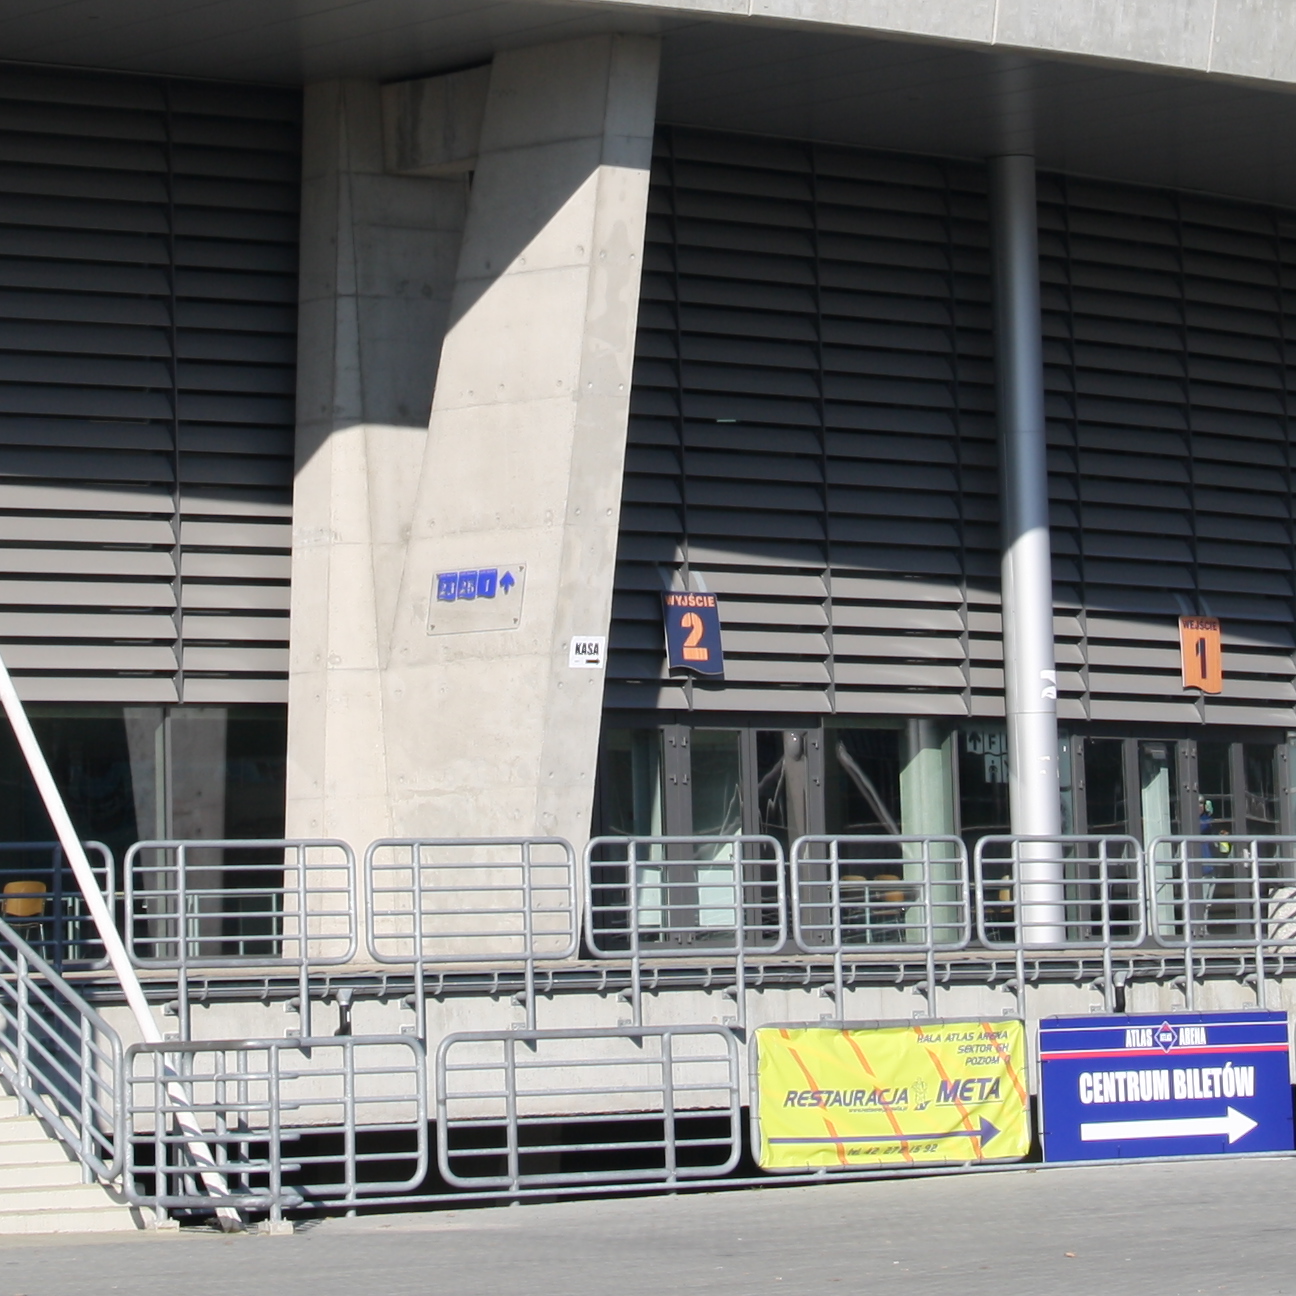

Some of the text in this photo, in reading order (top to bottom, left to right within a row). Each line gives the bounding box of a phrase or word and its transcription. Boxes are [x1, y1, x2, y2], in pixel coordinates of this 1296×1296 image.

[484, 578, 491, 593] 1
[666, 593, 716, 608] WYJŚCIE
[681, 612, 709, 661] 2
[574, 642, 600, 656] KASA
[1195, 638, 1207, 679] 1
[917, 1033, 942, 1043] HALA
[944, 1032, 974, 1042] ATLAS
[1125, 1027, 1207, 1048] ATLAS ARENA
[957, 1044, 992, 1054] SEKTOR
[965, 1055, 1000, 1066] POZIOM
[1079, 1062, 1255, 1104] CENTRUM BILETÓW
[783, 1077, 1002, 1108] RESTAURACJA META
